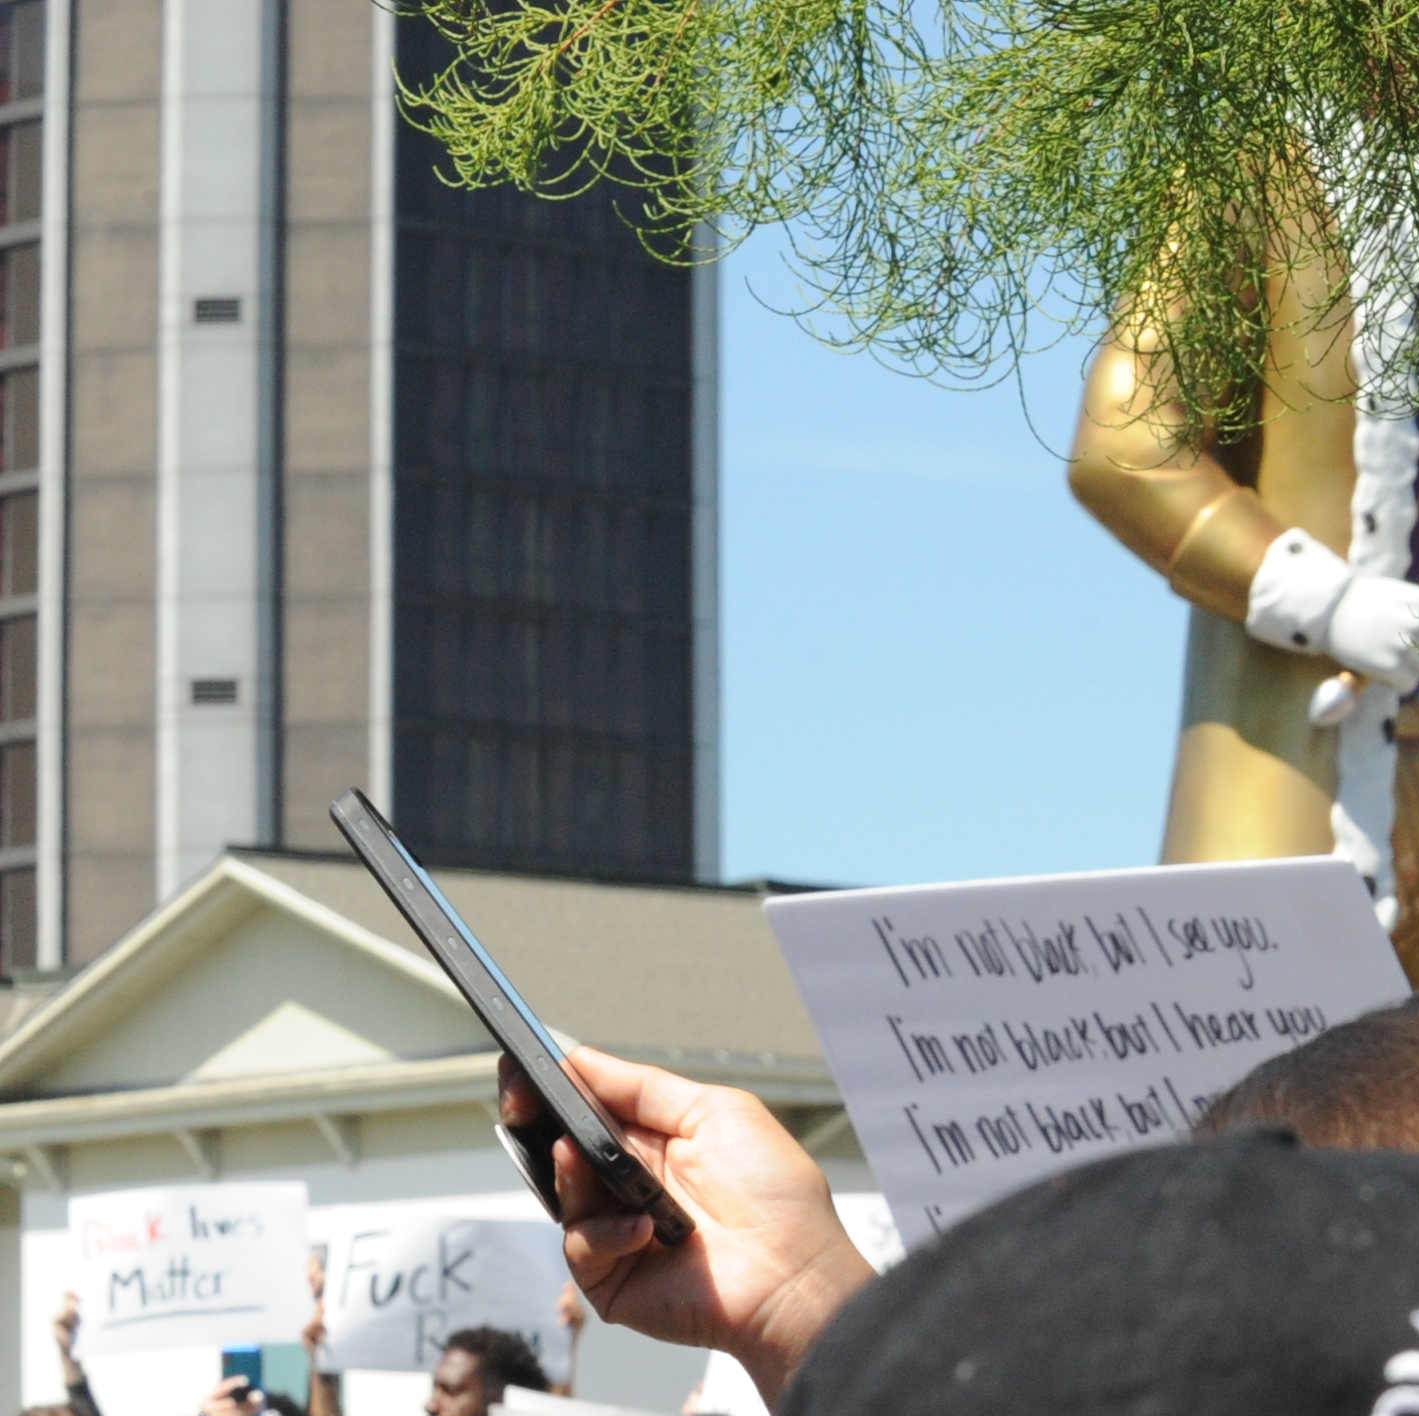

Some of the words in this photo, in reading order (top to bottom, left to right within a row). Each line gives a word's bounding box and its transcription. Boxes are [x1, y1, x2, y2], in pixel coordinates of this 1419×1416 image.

[873, 914, 953, 988] I'm
[954, 917, 1016, 977] not
[1084, 913, 1147, 974] but
[1137, 905, 1173, 967] I
[1168, 917, 1215, 960] see
[886, 1013, 955, 1083] I'm
[953, 1017, 1007, 1075] not
[1092, 1010, 1160, 1060] but
[1150, 1002, 1181, 1053] I
[1173, 1001, 1260, 1051] hear
[904, 1103, 976, 1175] I'm
[976, 1103, 1032, 1161] not
[1116, 1083, 1174, 1136] but
